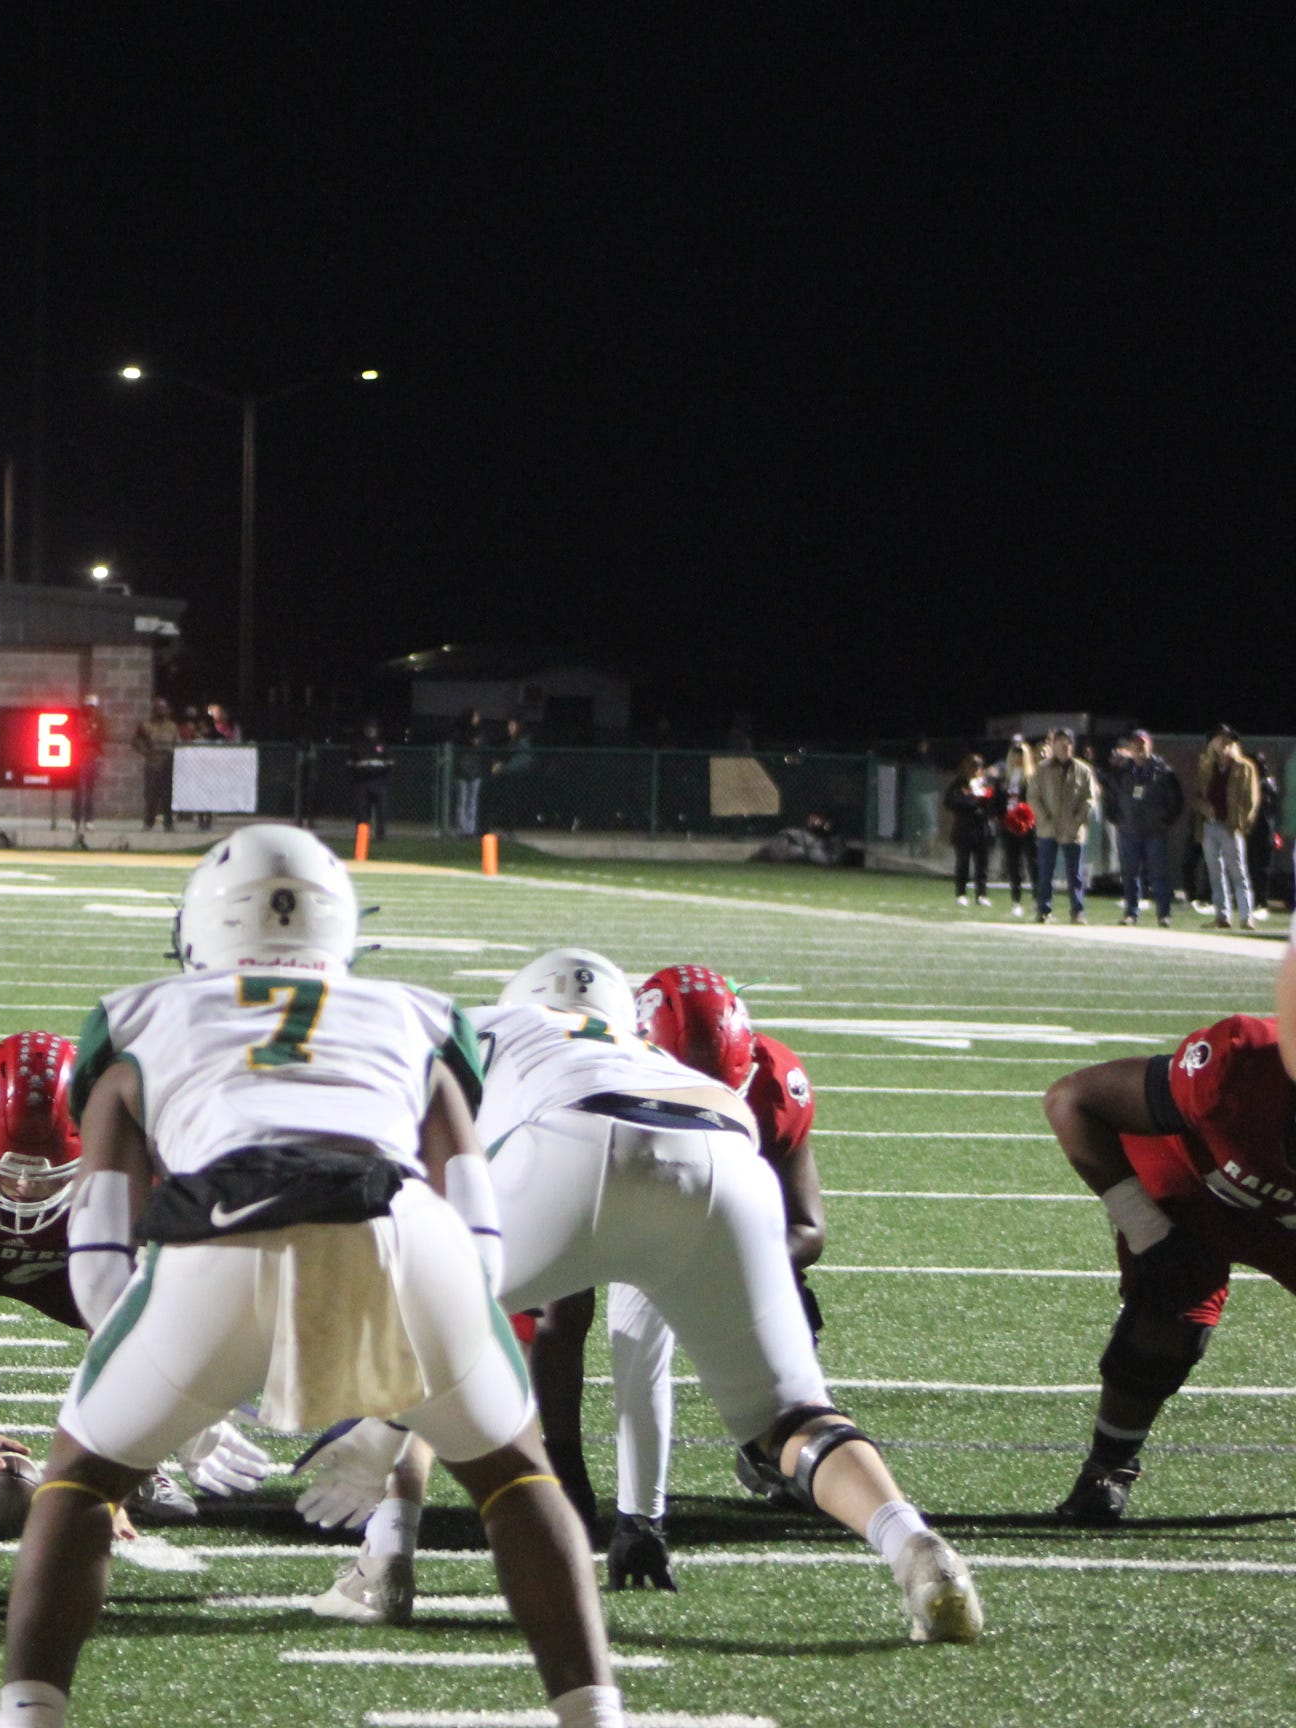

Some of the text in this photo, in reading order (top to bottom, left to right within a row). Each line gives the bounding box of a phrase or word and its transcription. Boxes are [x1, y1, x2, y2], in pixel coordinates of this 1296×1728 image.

[37, 713, 71, 767] 6
[236, 974, 329, 1071] 7
[1223, 1160, 1296, 1206] RAID
